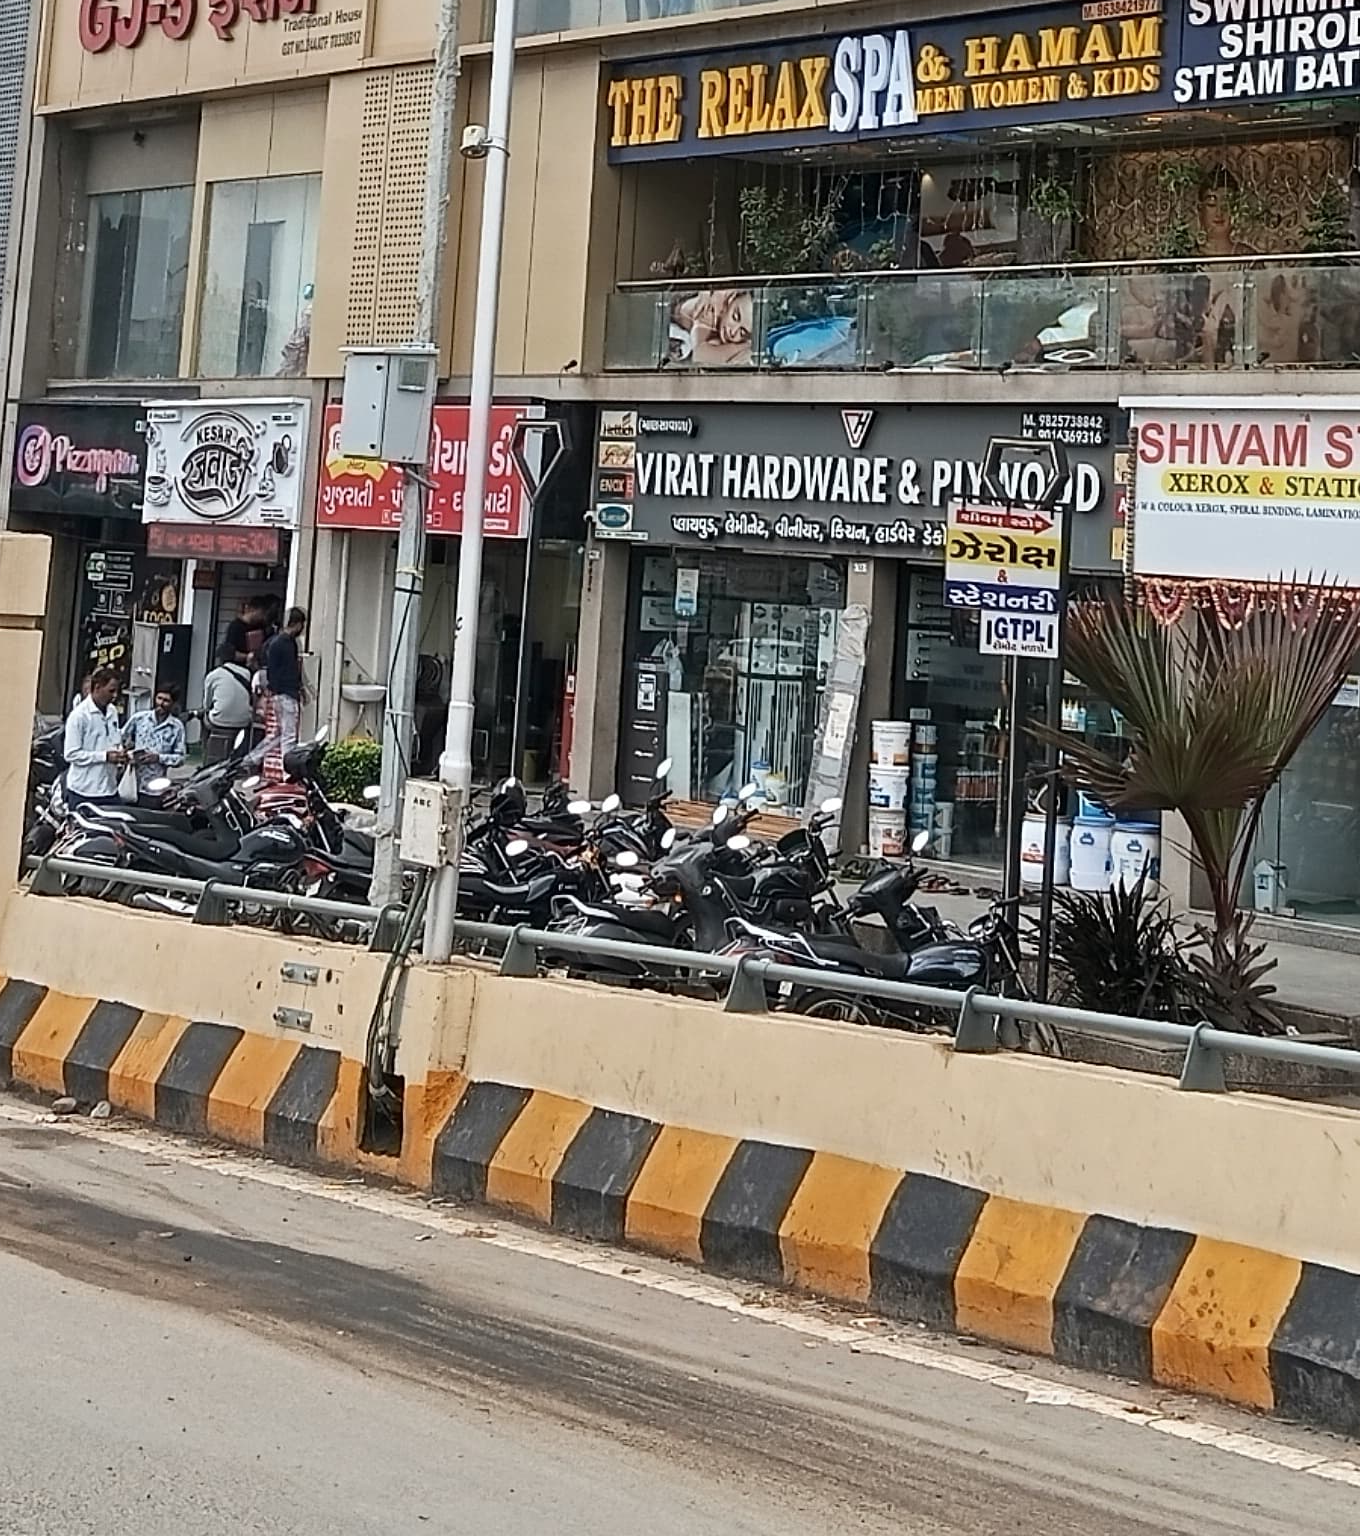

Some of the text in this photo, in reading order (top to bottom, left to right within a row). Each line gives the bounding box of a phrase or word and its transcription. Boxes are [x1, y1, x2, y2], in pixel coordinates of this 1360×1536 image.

[283, 11, 333, 33] Traditional
[916, 17, 1165, 82] & HAMAM
[828, 29, 919, 133] SPA
[916, 64, 1161, 115] MEN WOMEN & KIDS
[1173, 57, 1284, 104] STEAM
[607, 56, 830, 146] THE RELAX
[196, 426, 233, 445] KESAR
[1139, 420, 1309, 469] SHIVAM
[322, 478, 373, 515] ગુજરાતી
[636, 452, 922, 504] VIRAT HARDWARE &
[1166, 471, 1250, 495] XEROX
[1258, 473, 1276, 496] &
[949, 531, 1057, 570] ઝેરોક્ષ
[997, 569, 1008, 584] &
[948, 584, 1058, 612] સ્ટેશનરી
[994, 616, 1046, 643] GTPL
